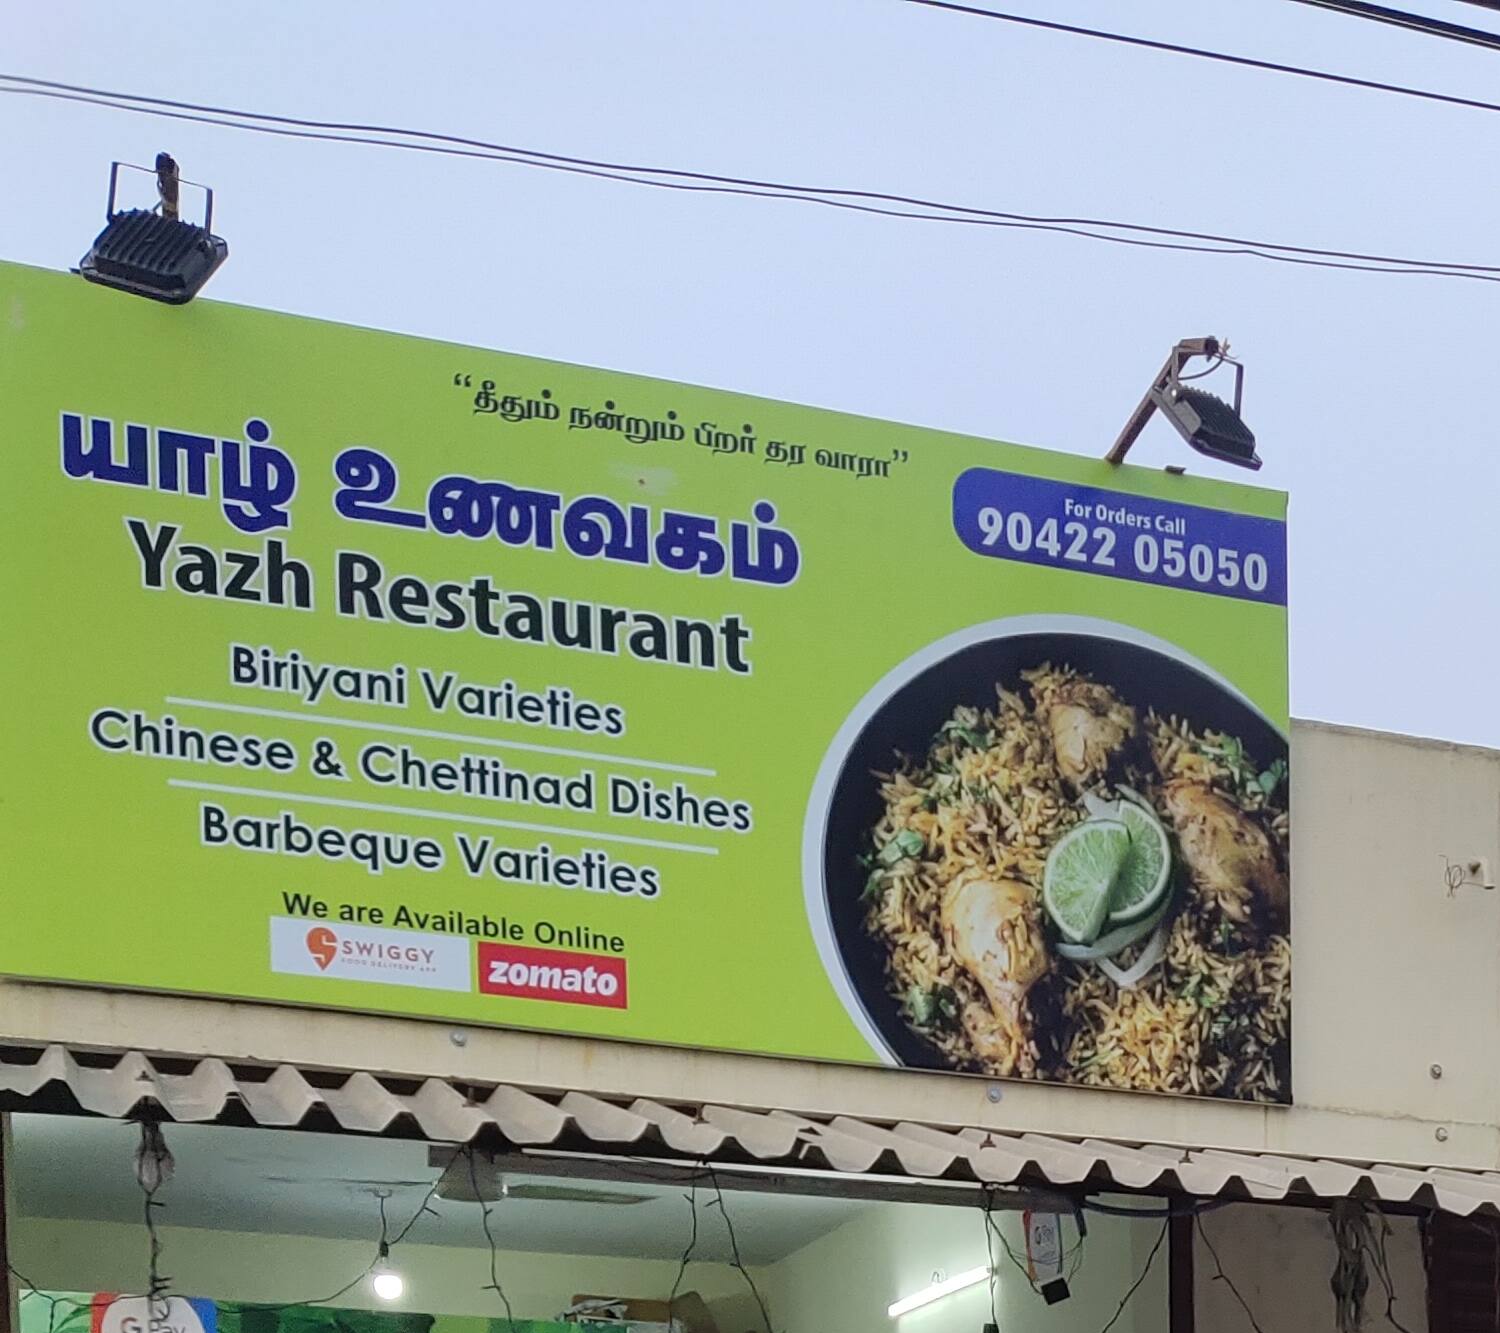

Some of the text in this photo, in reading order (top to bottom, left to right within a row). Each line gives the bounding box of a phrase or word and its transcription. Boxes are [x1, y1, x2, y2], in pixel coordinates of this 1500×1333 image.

[568, 400, 685, 445] நன்றும்
[694, 421, 758, 456] பிறர்
[764, 436, 807, 466] தர
[61, 412, 799, 586] யாழ் உணவகம்
[1064, 498, 1186, 536] For Orders Call
[977, 506, 1269, 592] 90422 05050
[128, 519, 750, 673] Yazh Restaurant
[231, 646, 624, 735] Biriyani Varieties
[91, 710, 752, 831] Chinese & Chettinad Dishes
[203, 805, 660, 897] Barbeque Varieties
[282, 891, 626, 954] We are Available Online
[342, 939, 436, 965] SWIGGY
[487, 959, 619, 997] zomato
